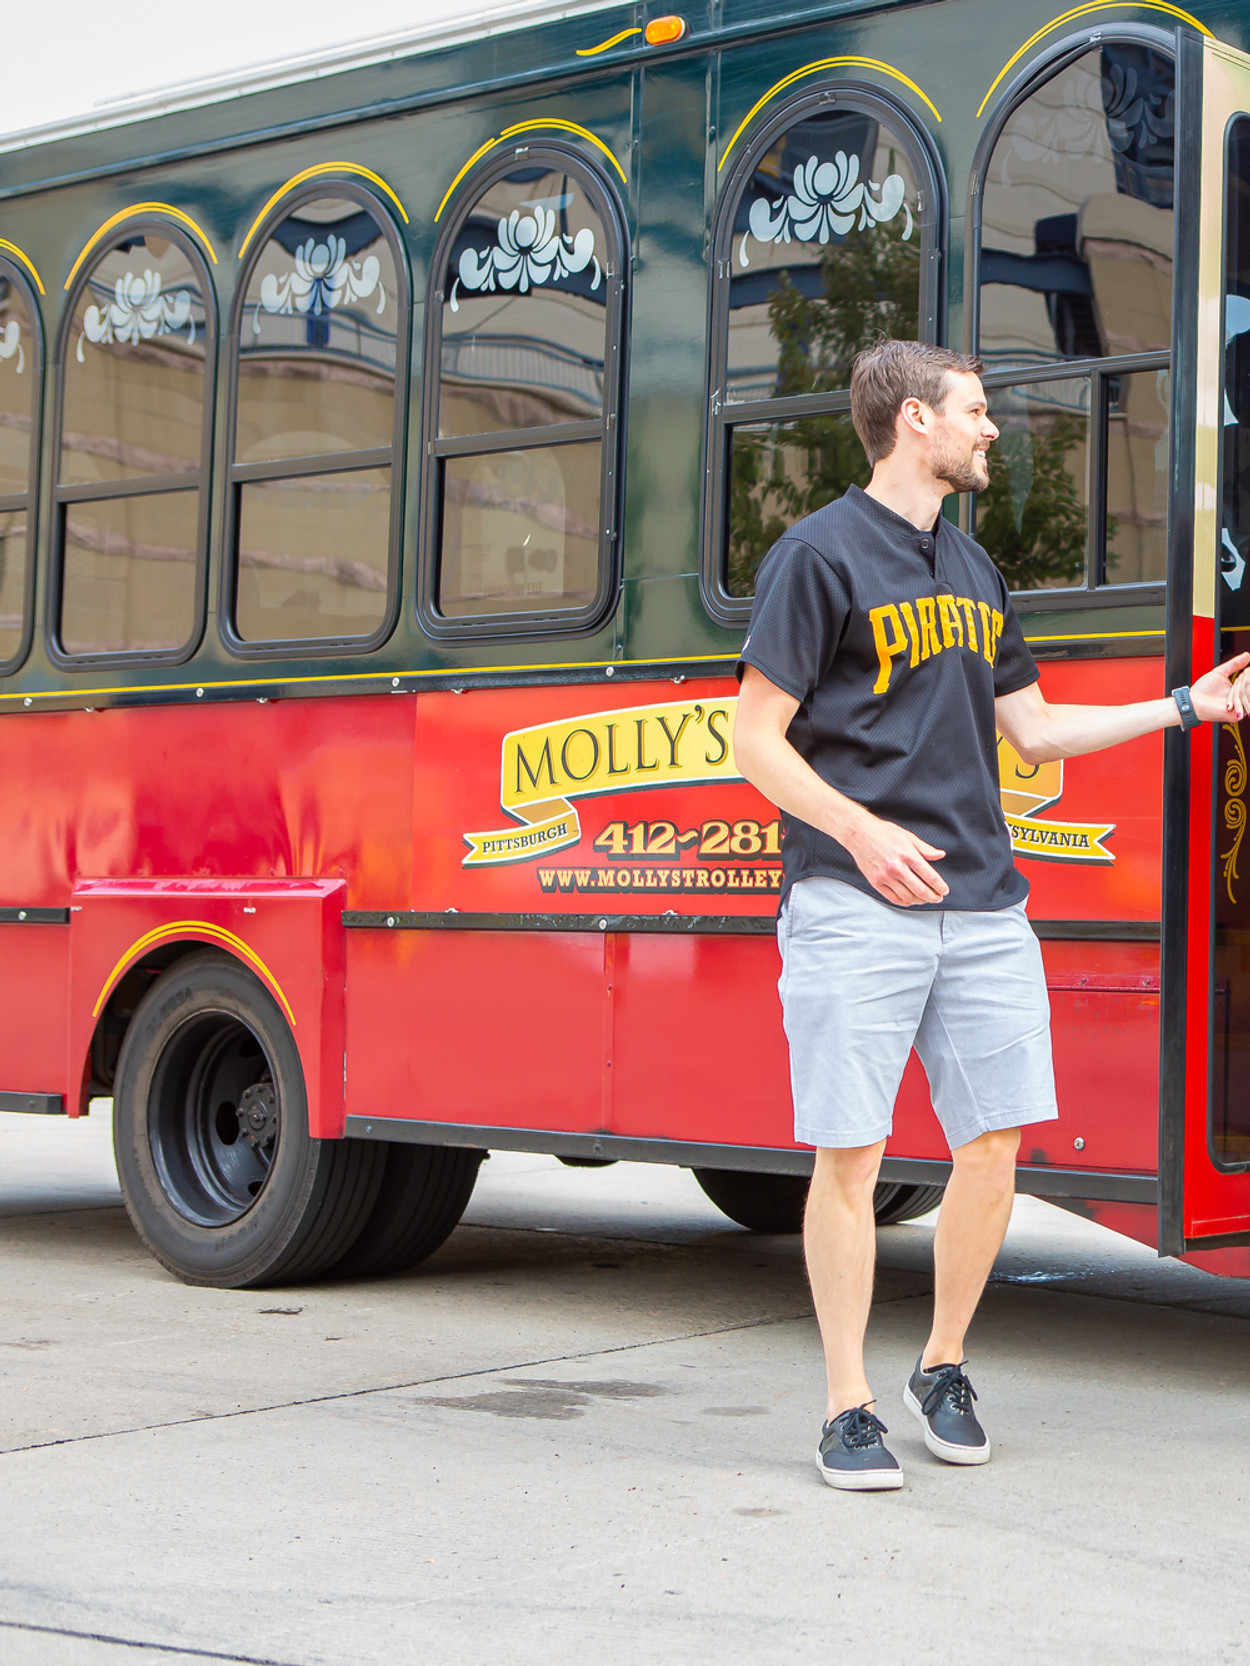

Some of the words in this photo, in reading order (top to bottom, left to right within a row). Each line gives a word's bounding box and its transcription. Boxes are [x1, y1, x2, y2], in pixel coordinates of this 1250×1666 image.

[513, 703, 730, 794] MOLLY'S
[482, 822, 568, 854] PITTSBURGH
[594, 820, 785, 855] 412~281
[537, 867, 785, 889] WWW.MOLLYSTROLLEY
